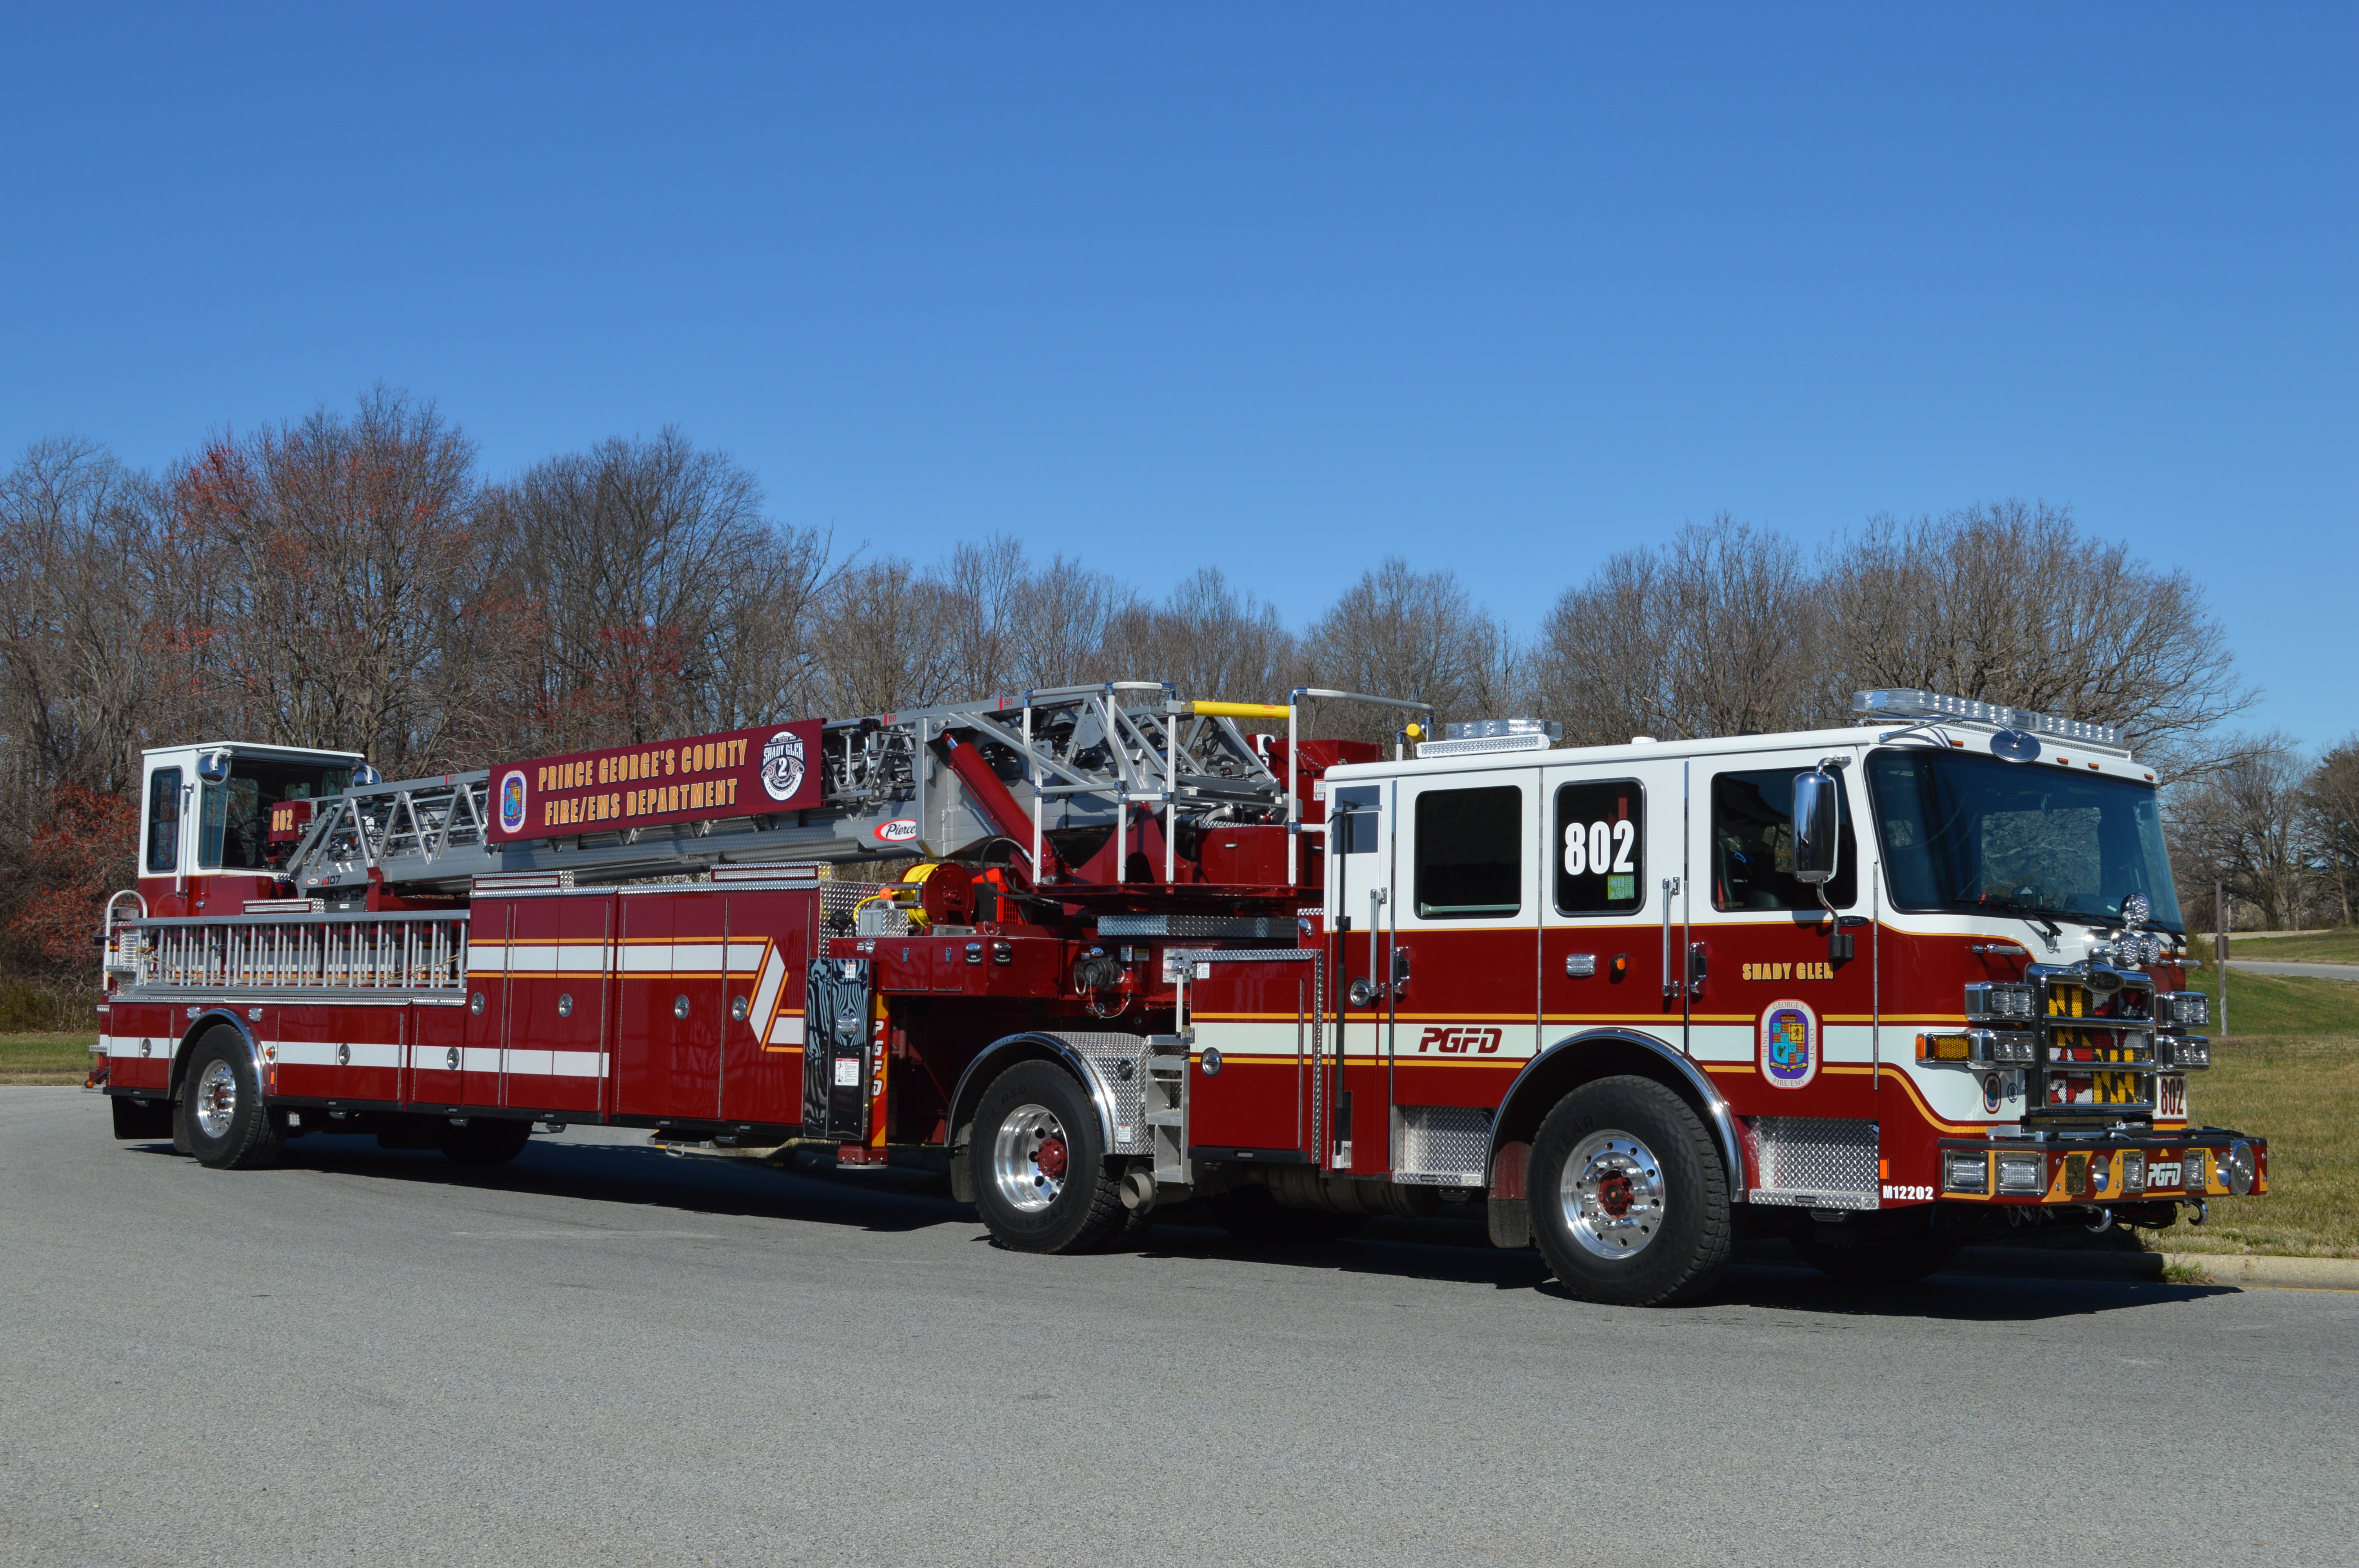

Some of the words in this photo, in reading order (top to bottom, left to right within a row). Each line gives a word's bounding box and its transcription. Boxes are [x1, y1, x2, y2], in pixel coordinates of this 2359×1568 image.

[763, 745, 784, 766] SHADY
[785, 742, 803, 762] GLEN
[539, 760, 593, 792] PRINCE
[599, 749, 675, 784] GEORGE'S
[682, 739, 748, 773] COUNTY
[778, 757, 787, 777] 2
[766, 782, 780, 797] ENGINE
[787, 779, 799, 795] TRUCK
[545, 793, 620, 826] FIRE/EMS
[627, 778, 737, 816] DEPARTMENT
[273, 809, 293, 831] 802
[885, 823, 916, 838] Pierce
[1565, 820, 1634, 875] 802
[1743, 963, 1792, 980] SHADY
[1796, 962, 1833, 980] GLEN
[1773, 1001, 1805, 1010] GEORGE'S
[1418, 1027, 1503, 1053] PGFD
[1773, 1078, 1805, 1087] FIRE/EMS
[2161, 1078, 2183, 1115] 802
[2146, 1162, 2181, 1187] PGFD
[1883, 1185, 1934, 1200] M12202
